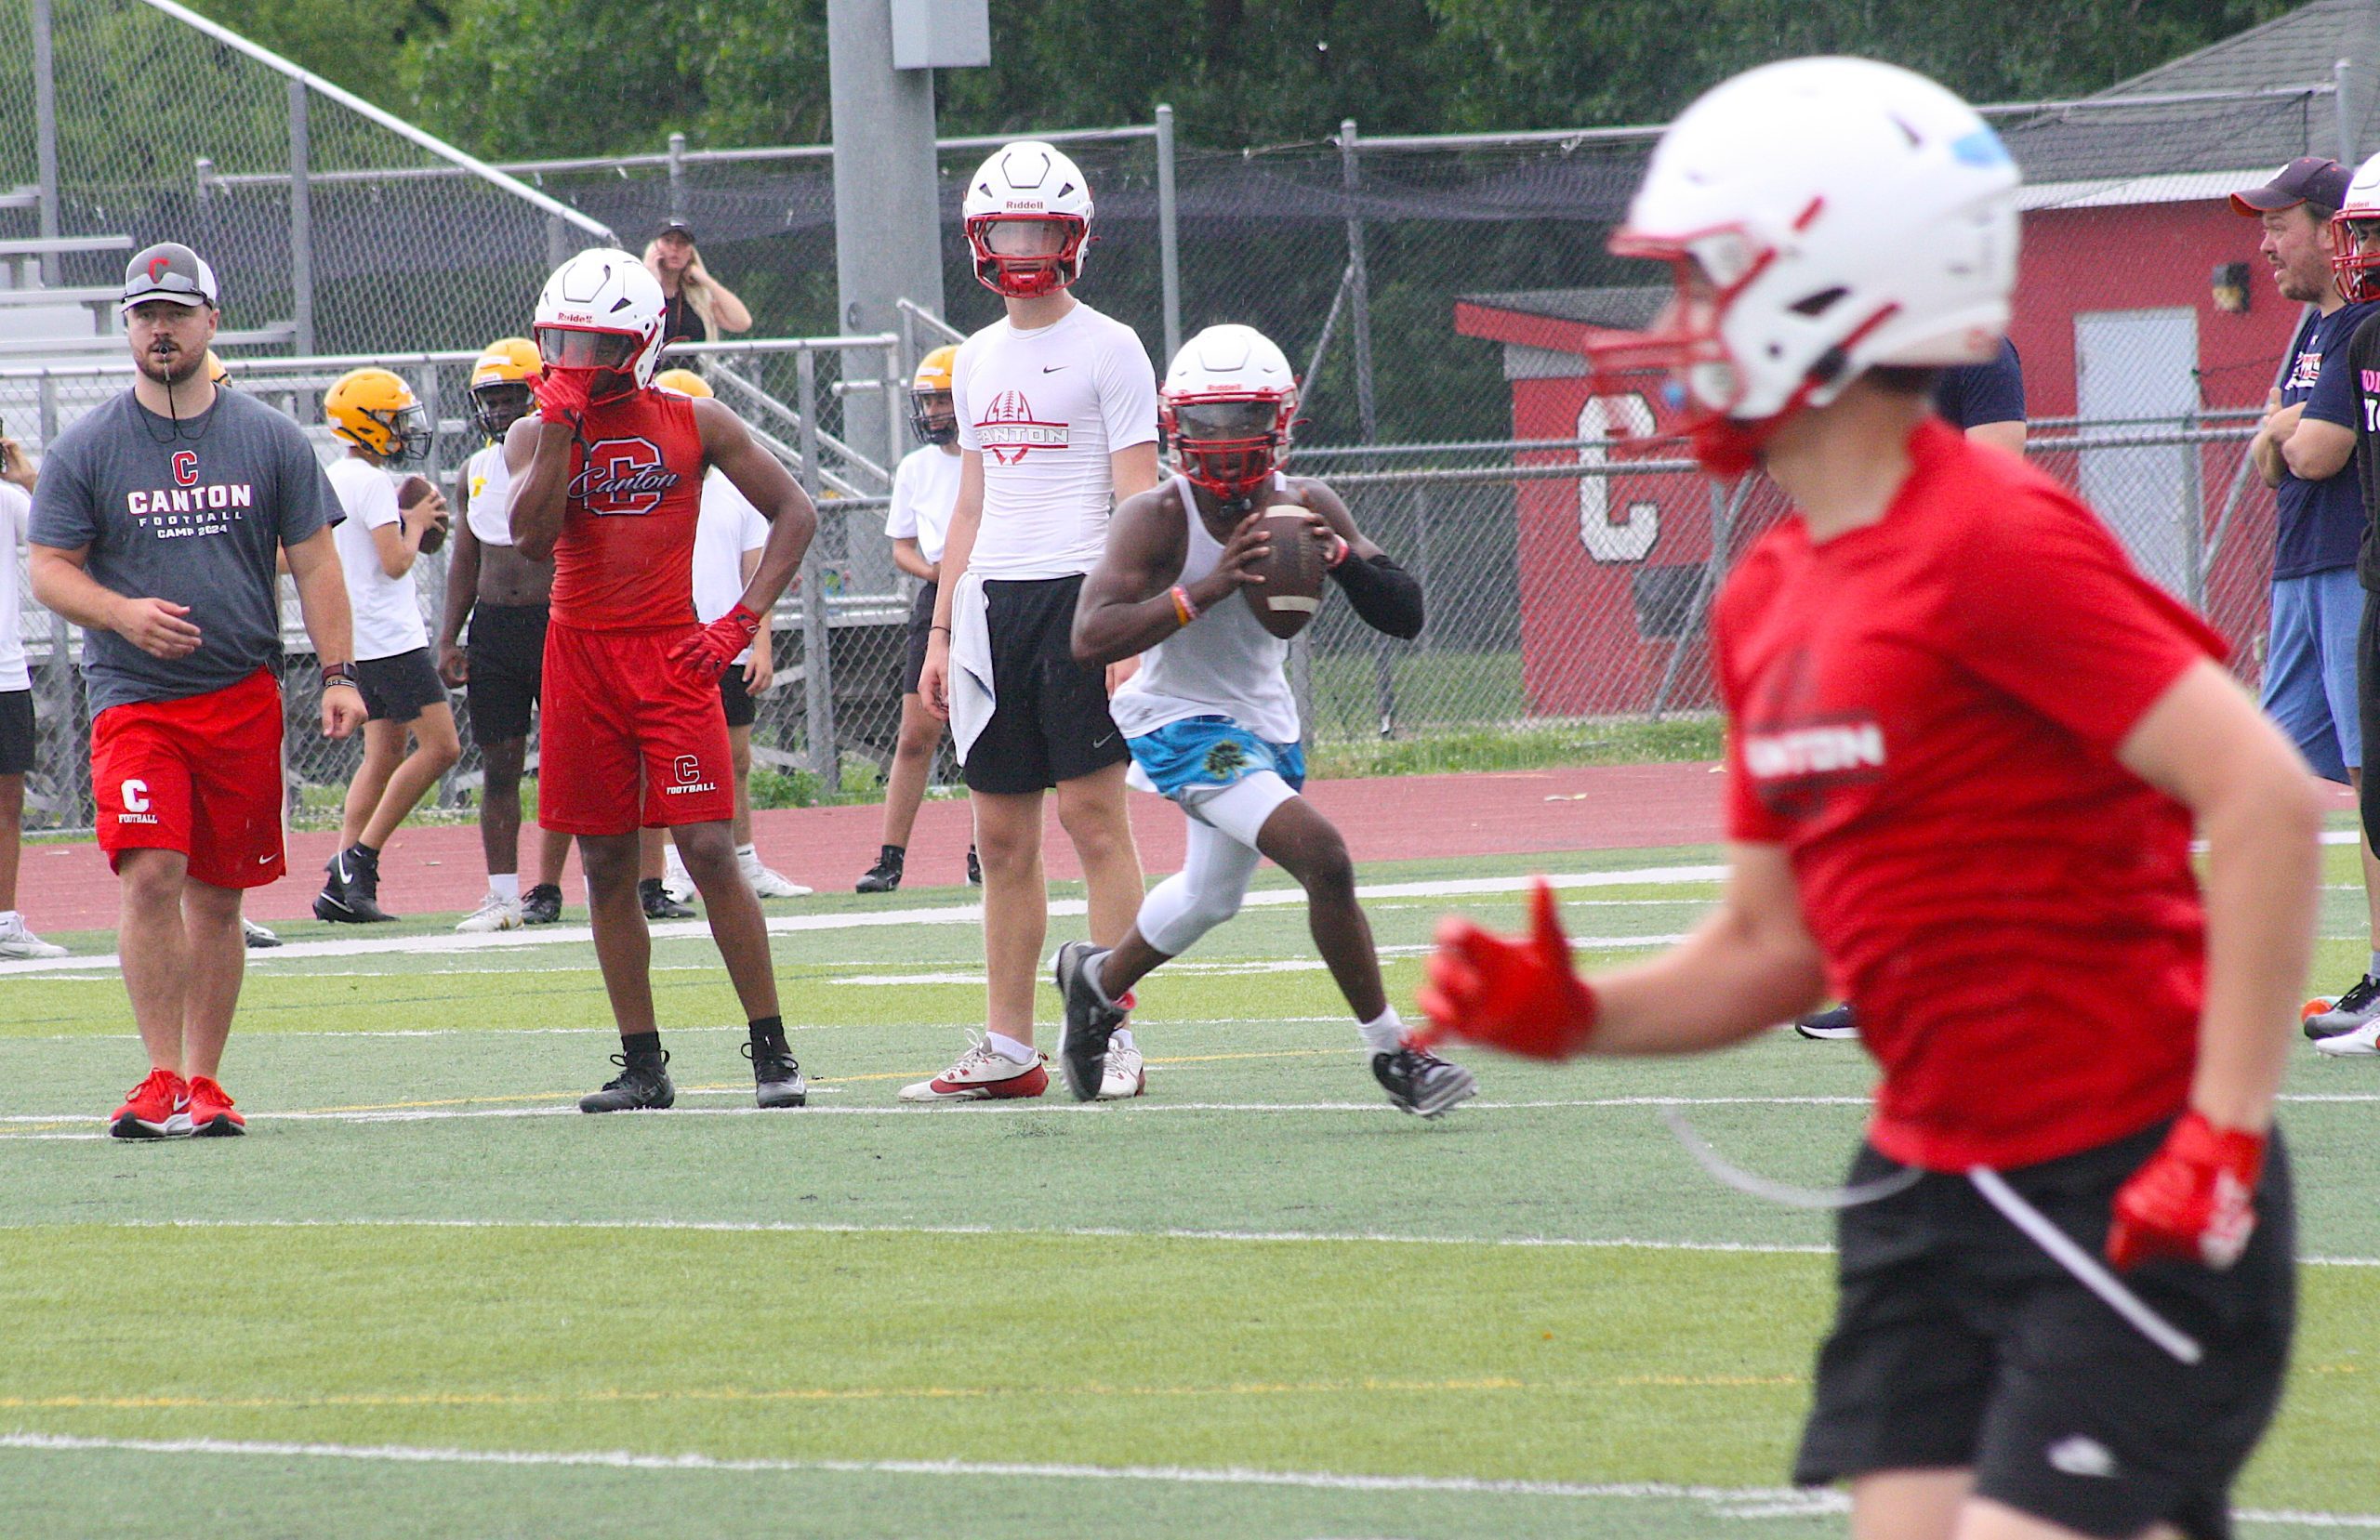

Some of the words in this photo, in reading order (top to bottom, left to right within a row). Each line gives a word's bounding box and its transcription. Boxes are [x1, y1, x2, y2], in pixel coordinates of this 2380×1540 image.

[1006, 201, 1044, 209] Riddell
[171, 450, 199, 487] C
[567, 466, 679, 499] Canton
[1577, 390, 1659, 564] C
[127, 484, 252, 515] CANTON
[139, 511, 243, 527] FOOTBALL
[157, 528, 194, 539] CAMP
[198, 524, 228, 536] 2024
[674, 754, 700, 784] C
[121, 779, 150, 813] C
[667, 782, 717, 795] FOOTBALL
[118, 813, 158, 824] FOOTBALL
